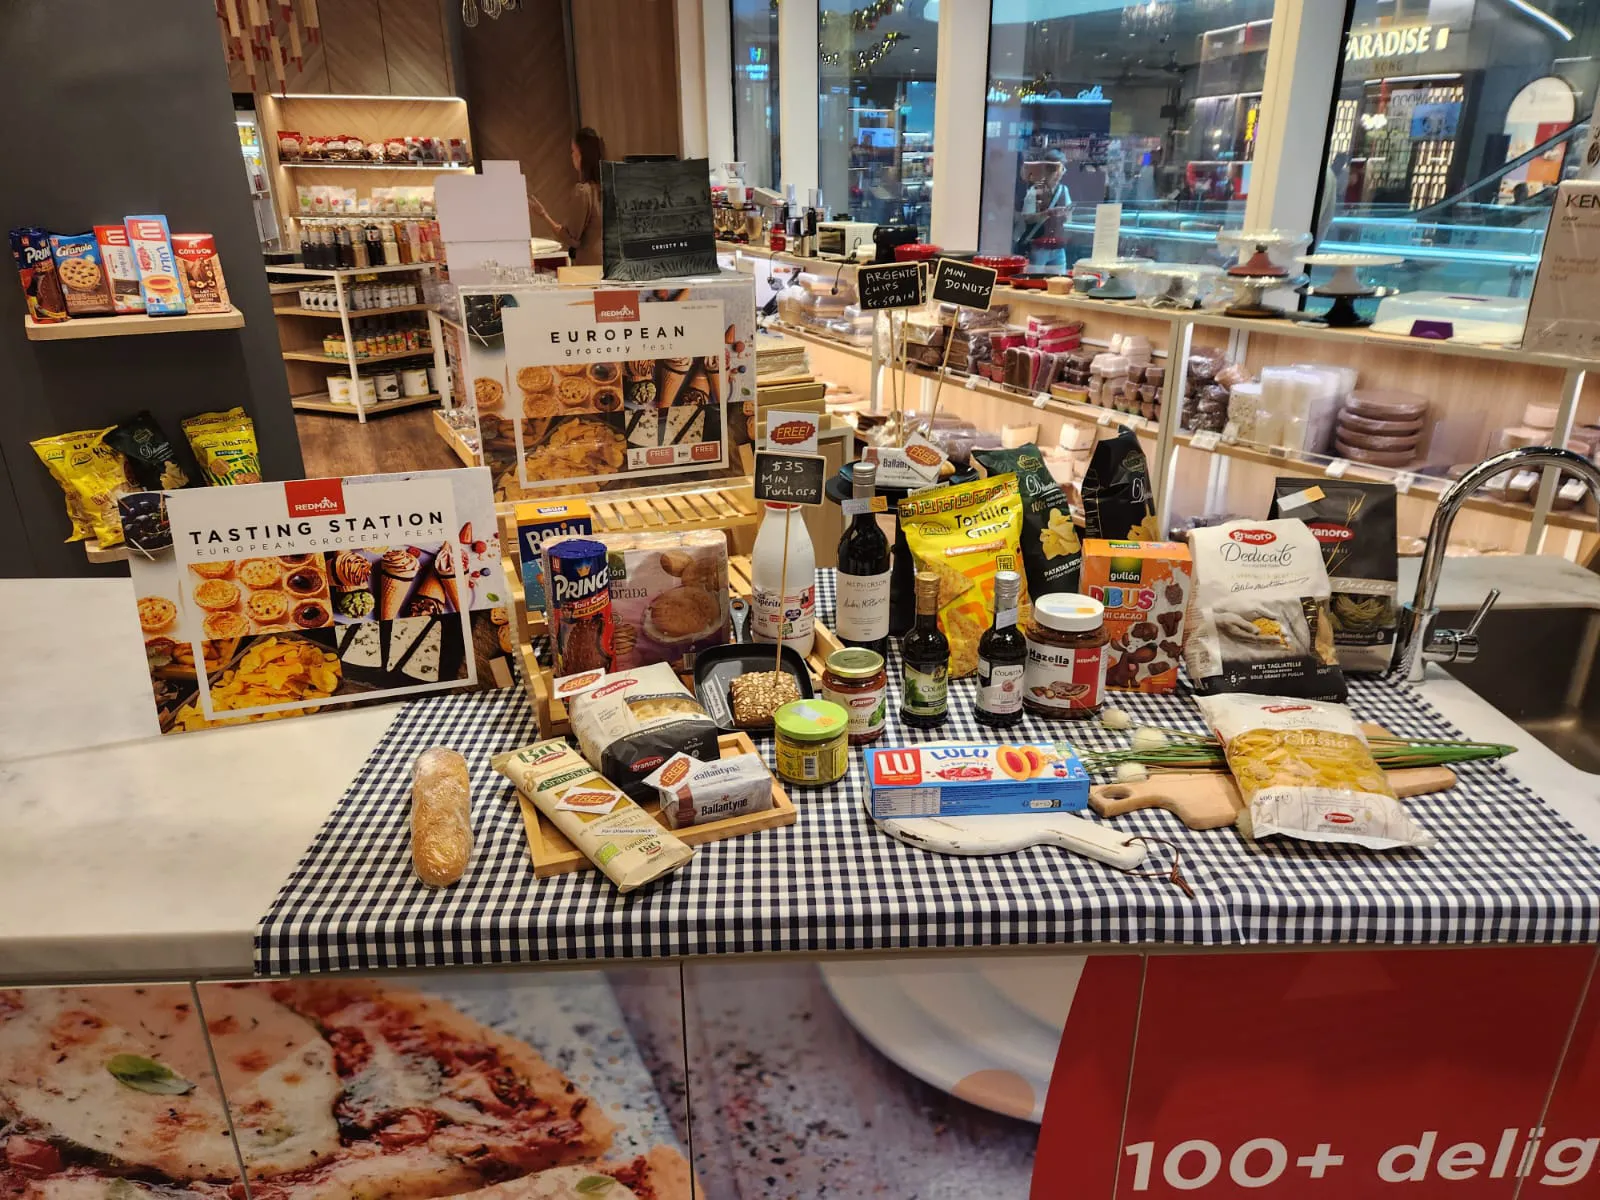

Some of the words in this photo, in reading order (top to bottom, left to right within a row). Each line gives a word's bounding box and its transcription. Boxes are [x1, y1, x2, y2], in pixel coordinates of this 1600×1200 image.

[1345, 26, 1431, 61] ARADISE
[56, 243, 93, 257] Granola
[865, 266, 918, 283] ARGENTE
[943, 266, 967, 279] MINI
[864, 282, 899, 296] CHIPS
[945, 279, 990, 296] DONUTS
[600, 308, 635, 318] REDMAN
[550, 325, 685, 344] EUROPEAN
[565, 345, 631, 357] grocery
[642, 343, 673, 351] fest
[776, 426, 811, 440] FREE!
[909, 445, 938, 465] FREE!
[772, 460, 804, 473] $35
[883, 458, 911, 471] Ballanty
[761, 474, 789, 484] MIN
[295, 498, 338, 512] REDMAN
[954, 504, 1010, 530] Tortilla
[188, 521, 313, 546] TASTING
[328, 510, 443, 534] STATION
[965, 518, 1012, 540] Chips
[1312, 528, 1351, 538] ranoro
[196, 539, 296, 556] EUROPEAN
[309, 531, 391, 547] GROCERY
[404, 527, 445, 538] FEST
[1219, 542, 1297, 567] Dedicato
[1110, 571, 1141, 582] gullón
[1090, 585, 1157, 611] DIBUS
[1113, 612, 1144, 620] CACAO
[1029, 648, 1069, 665] Hazella
[562, 672, 601, 690] FREE!
[930, 748, 990, 761] LULU
[662, 759, 691, 785] FREE!
[877, 752, 917, 776] LU
[569, 793, 613, 803] FREE!
[701, 798, 749, 817] Ballantyne
[1124, 1137, 1345, 1192] 100+
